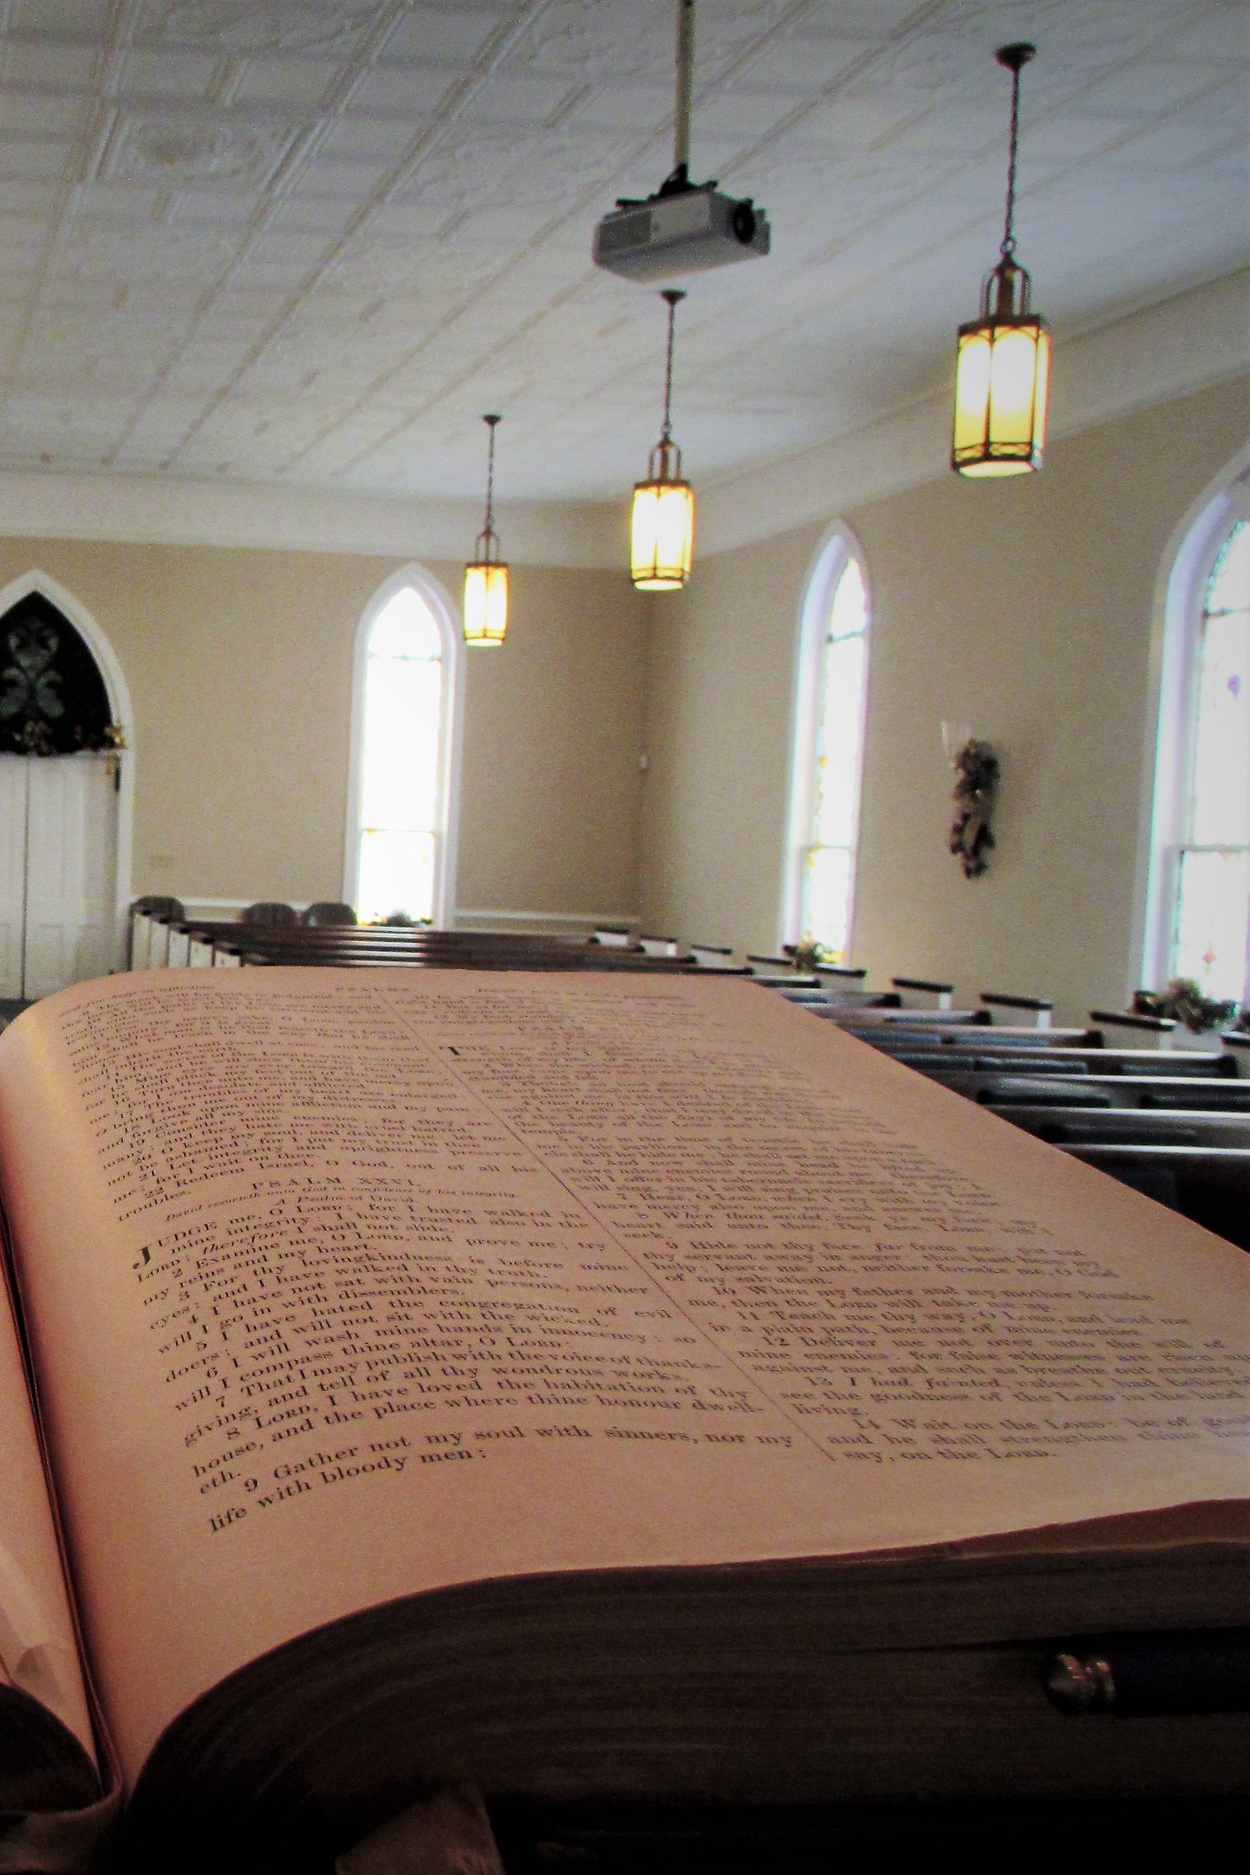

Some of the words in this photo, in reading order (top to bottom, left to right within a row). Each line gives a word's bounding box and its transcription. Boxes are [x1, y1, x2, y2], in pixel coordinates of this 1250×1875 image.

[252, 1177, 342, 1191] PSALM
[357, 1177, 420, 1188] XXVI.
[215, 1396, 226, 1408] 7
[240, 1375, 296, 1398] That
[299, 1369, 307, 1381] I
[312, 1361, 359, 1377] may
[365, 1351, 448, 1371] publish
[451, 1351, 500, 1363] with
[507, 1350, 543, 1362] the
[547, 1352, 603, 1364] voice
[605, 1353, 631, 1365] of
[268, 1385, 310, 1407] and
[318, 1374, 356, 1393] tell
[366, 1370, 391, 1384] of
[403, 1366, 432, 1380] all
[441, 1365, 479, 1380] thy
[490, 1364, 602, 1377] wondrous
[191, 1440, 265, 1478] house,
[272, 1418, 314, 1442] and
[324, 1409, 364, 1426] the
[372, 1399, 438, 1419] place
[445, 1393, 519, 1409] where
[526, 1392, 589, 1406] thine
[600, 1395, 682, 1411] honour
[692, 1398, 764, 1414] dwell-
[226, 1427, 241, 1441] 8
[254, 1403, 319, 1430] LORD,
[328, 1394, 338, 1407] I
[351, 1385, 409, 1402] have
[418, 1379, 483, 1394] loved
[497, 1378, 535, 1390] the
[543, 1378, 667, 1396] habitation
[674, 1384, 699, 1396] of
[709, 1386, 750, 1400] thy
[199, 1471, 242, 1495] eth.
[243, 1478, 259, 1492] 9
[273, 1446, 358, 1480] Gather
[370, 1436, 411, 1453] not
[425, 1430, 463, 1446] my
[474, 1425, 526, 1440] soul
[533, 1425, 592, 1439] with
[604, 1426, 699, 1445] sinners,
[704, 1431, 746, 1444] nor
[755, 1434, 792, 1448] my
[208, 1506, 248, 1534] life
[255, 1479, 312, 1508] with
[319, 1454, 408, 1485] bloody
[419, 1447, 487, 1465] men:
